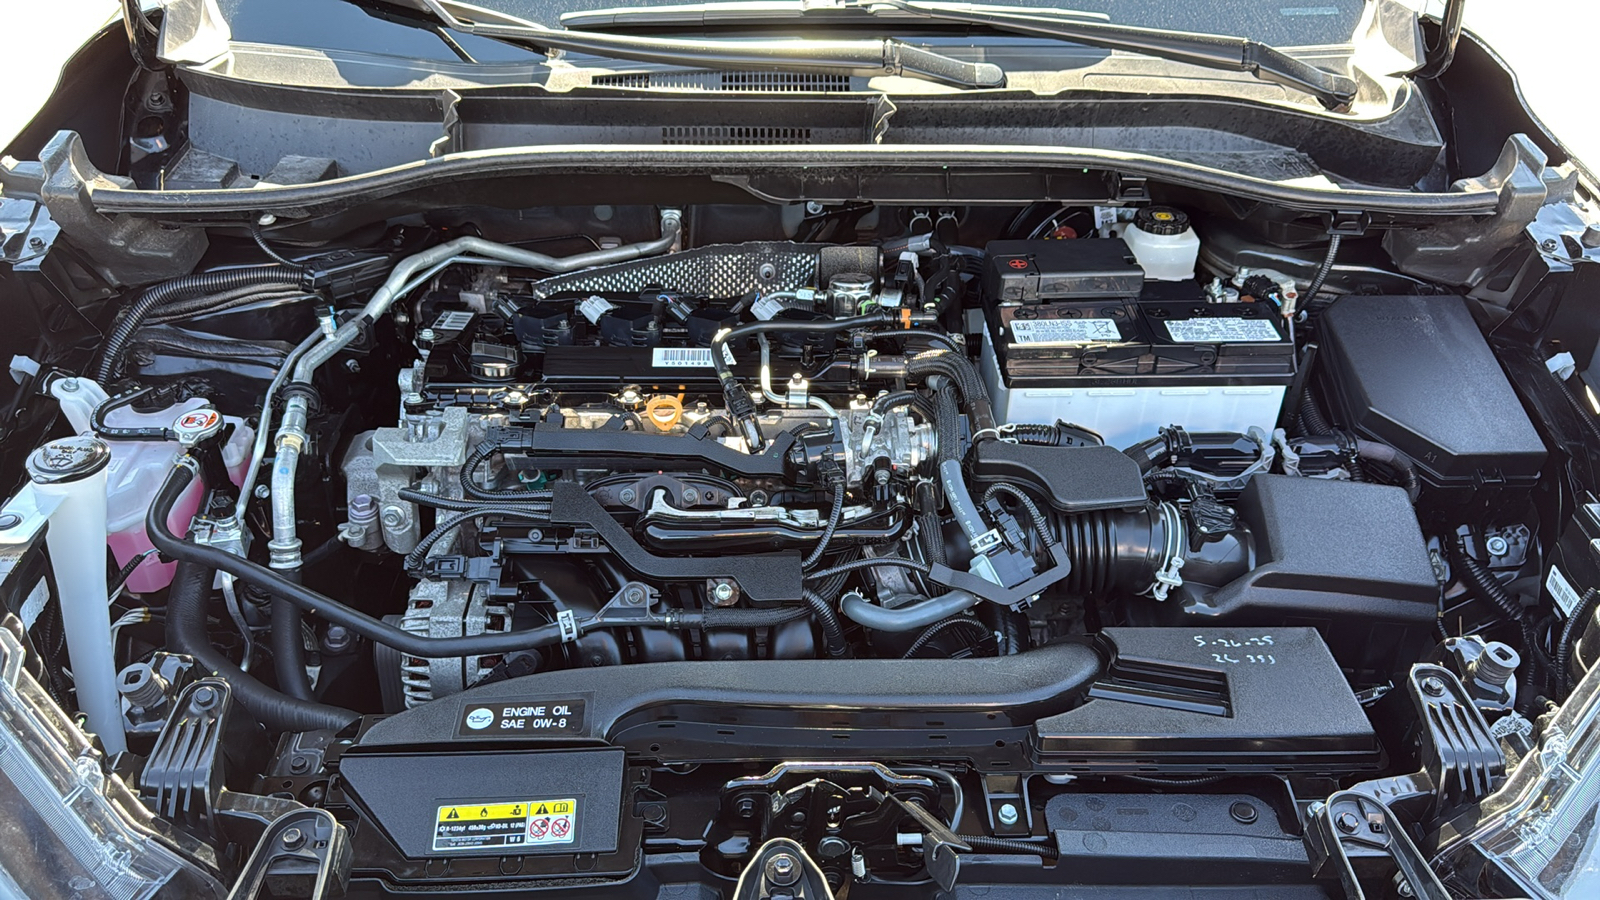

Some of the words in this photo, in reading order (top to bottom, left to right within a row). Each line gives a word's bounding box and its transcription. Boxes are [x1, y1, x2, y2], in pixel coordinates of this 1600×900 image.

[1424, 451, 1437, 463] A1
[502, 706, 546, 717] ENGINE
[552, 705, 572, 716] OIL
[500, 719, 525, 729] SAE
[532, 718, 567, 729] 0W-8
